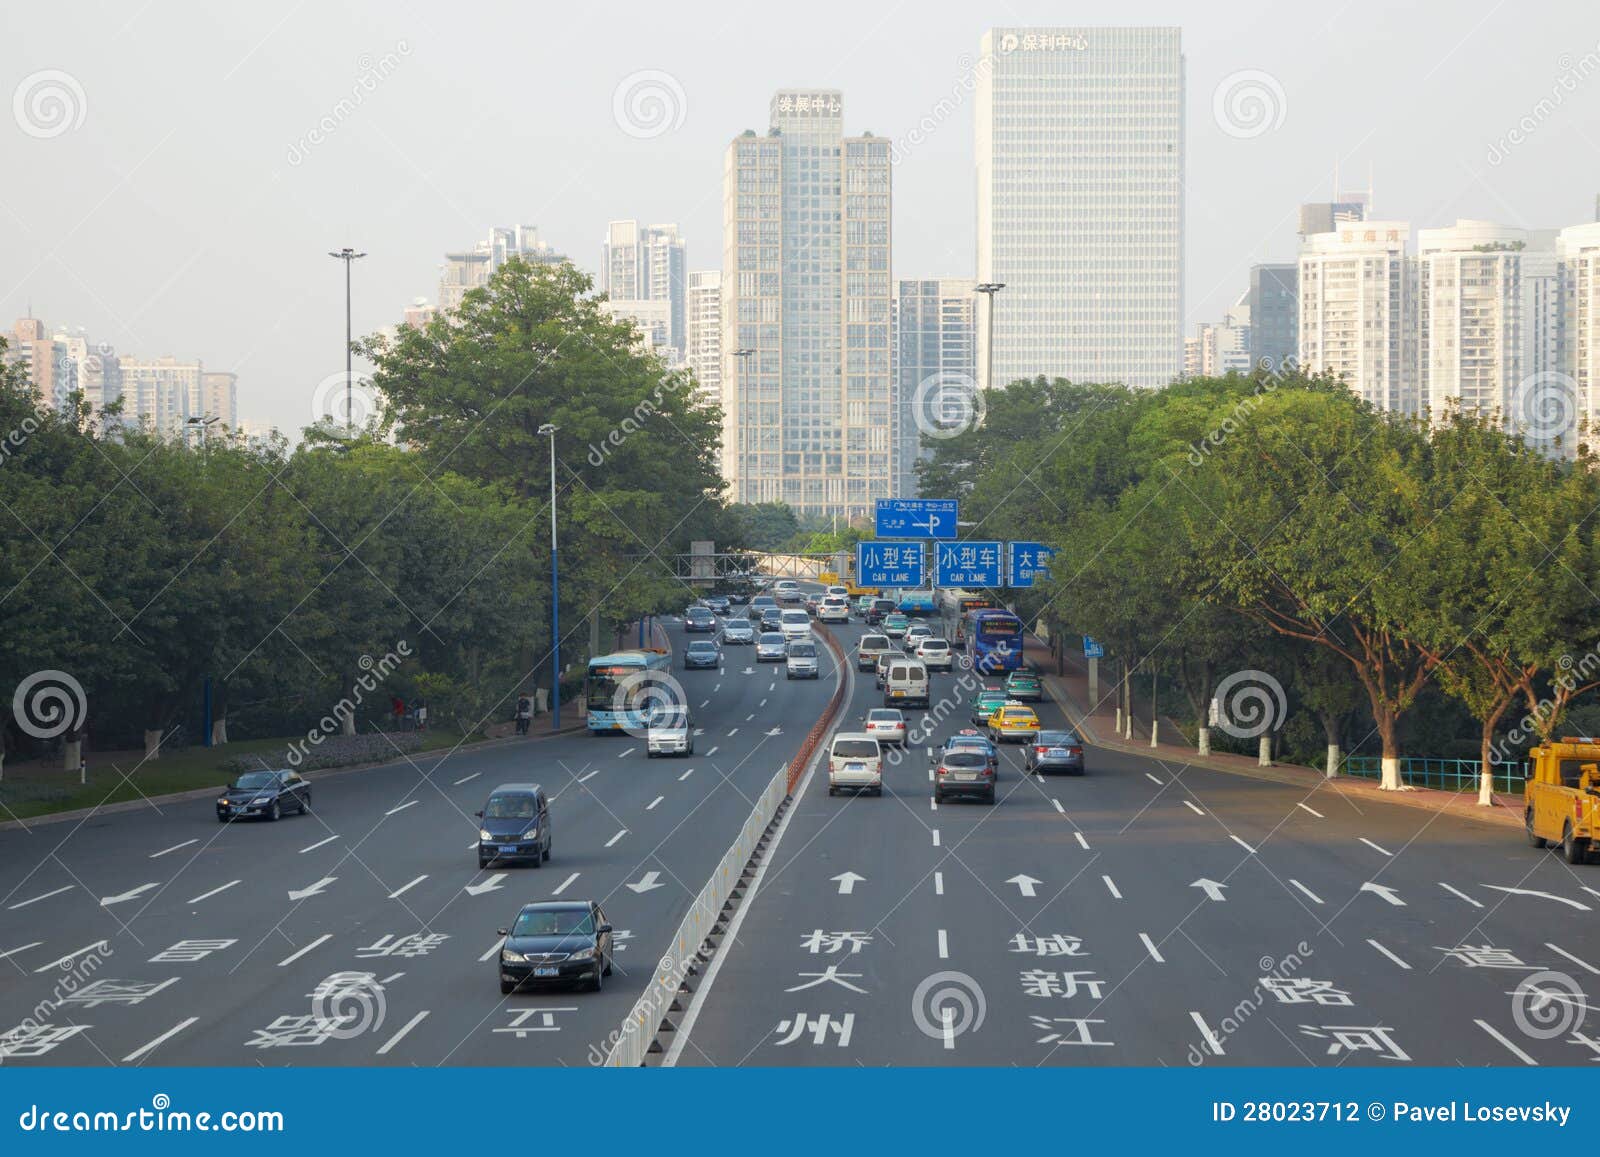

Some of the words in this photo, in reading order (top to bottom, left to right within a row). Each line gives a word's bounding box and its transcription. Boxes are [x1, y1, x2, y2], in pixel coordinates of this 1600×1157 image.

[1021, 33, 1089, 51] 保利中心
[779, 95, 842, 113] 发展中心
[864, 547, 919, 570] 小型车
[942, 547, 995, 570] 小型车
[872, 573, 887, 583] CAR
[890, 573, 910, 583] LANE
[950, 573, 965, 583] CAR
[969, 573, 988, 583] LANE
